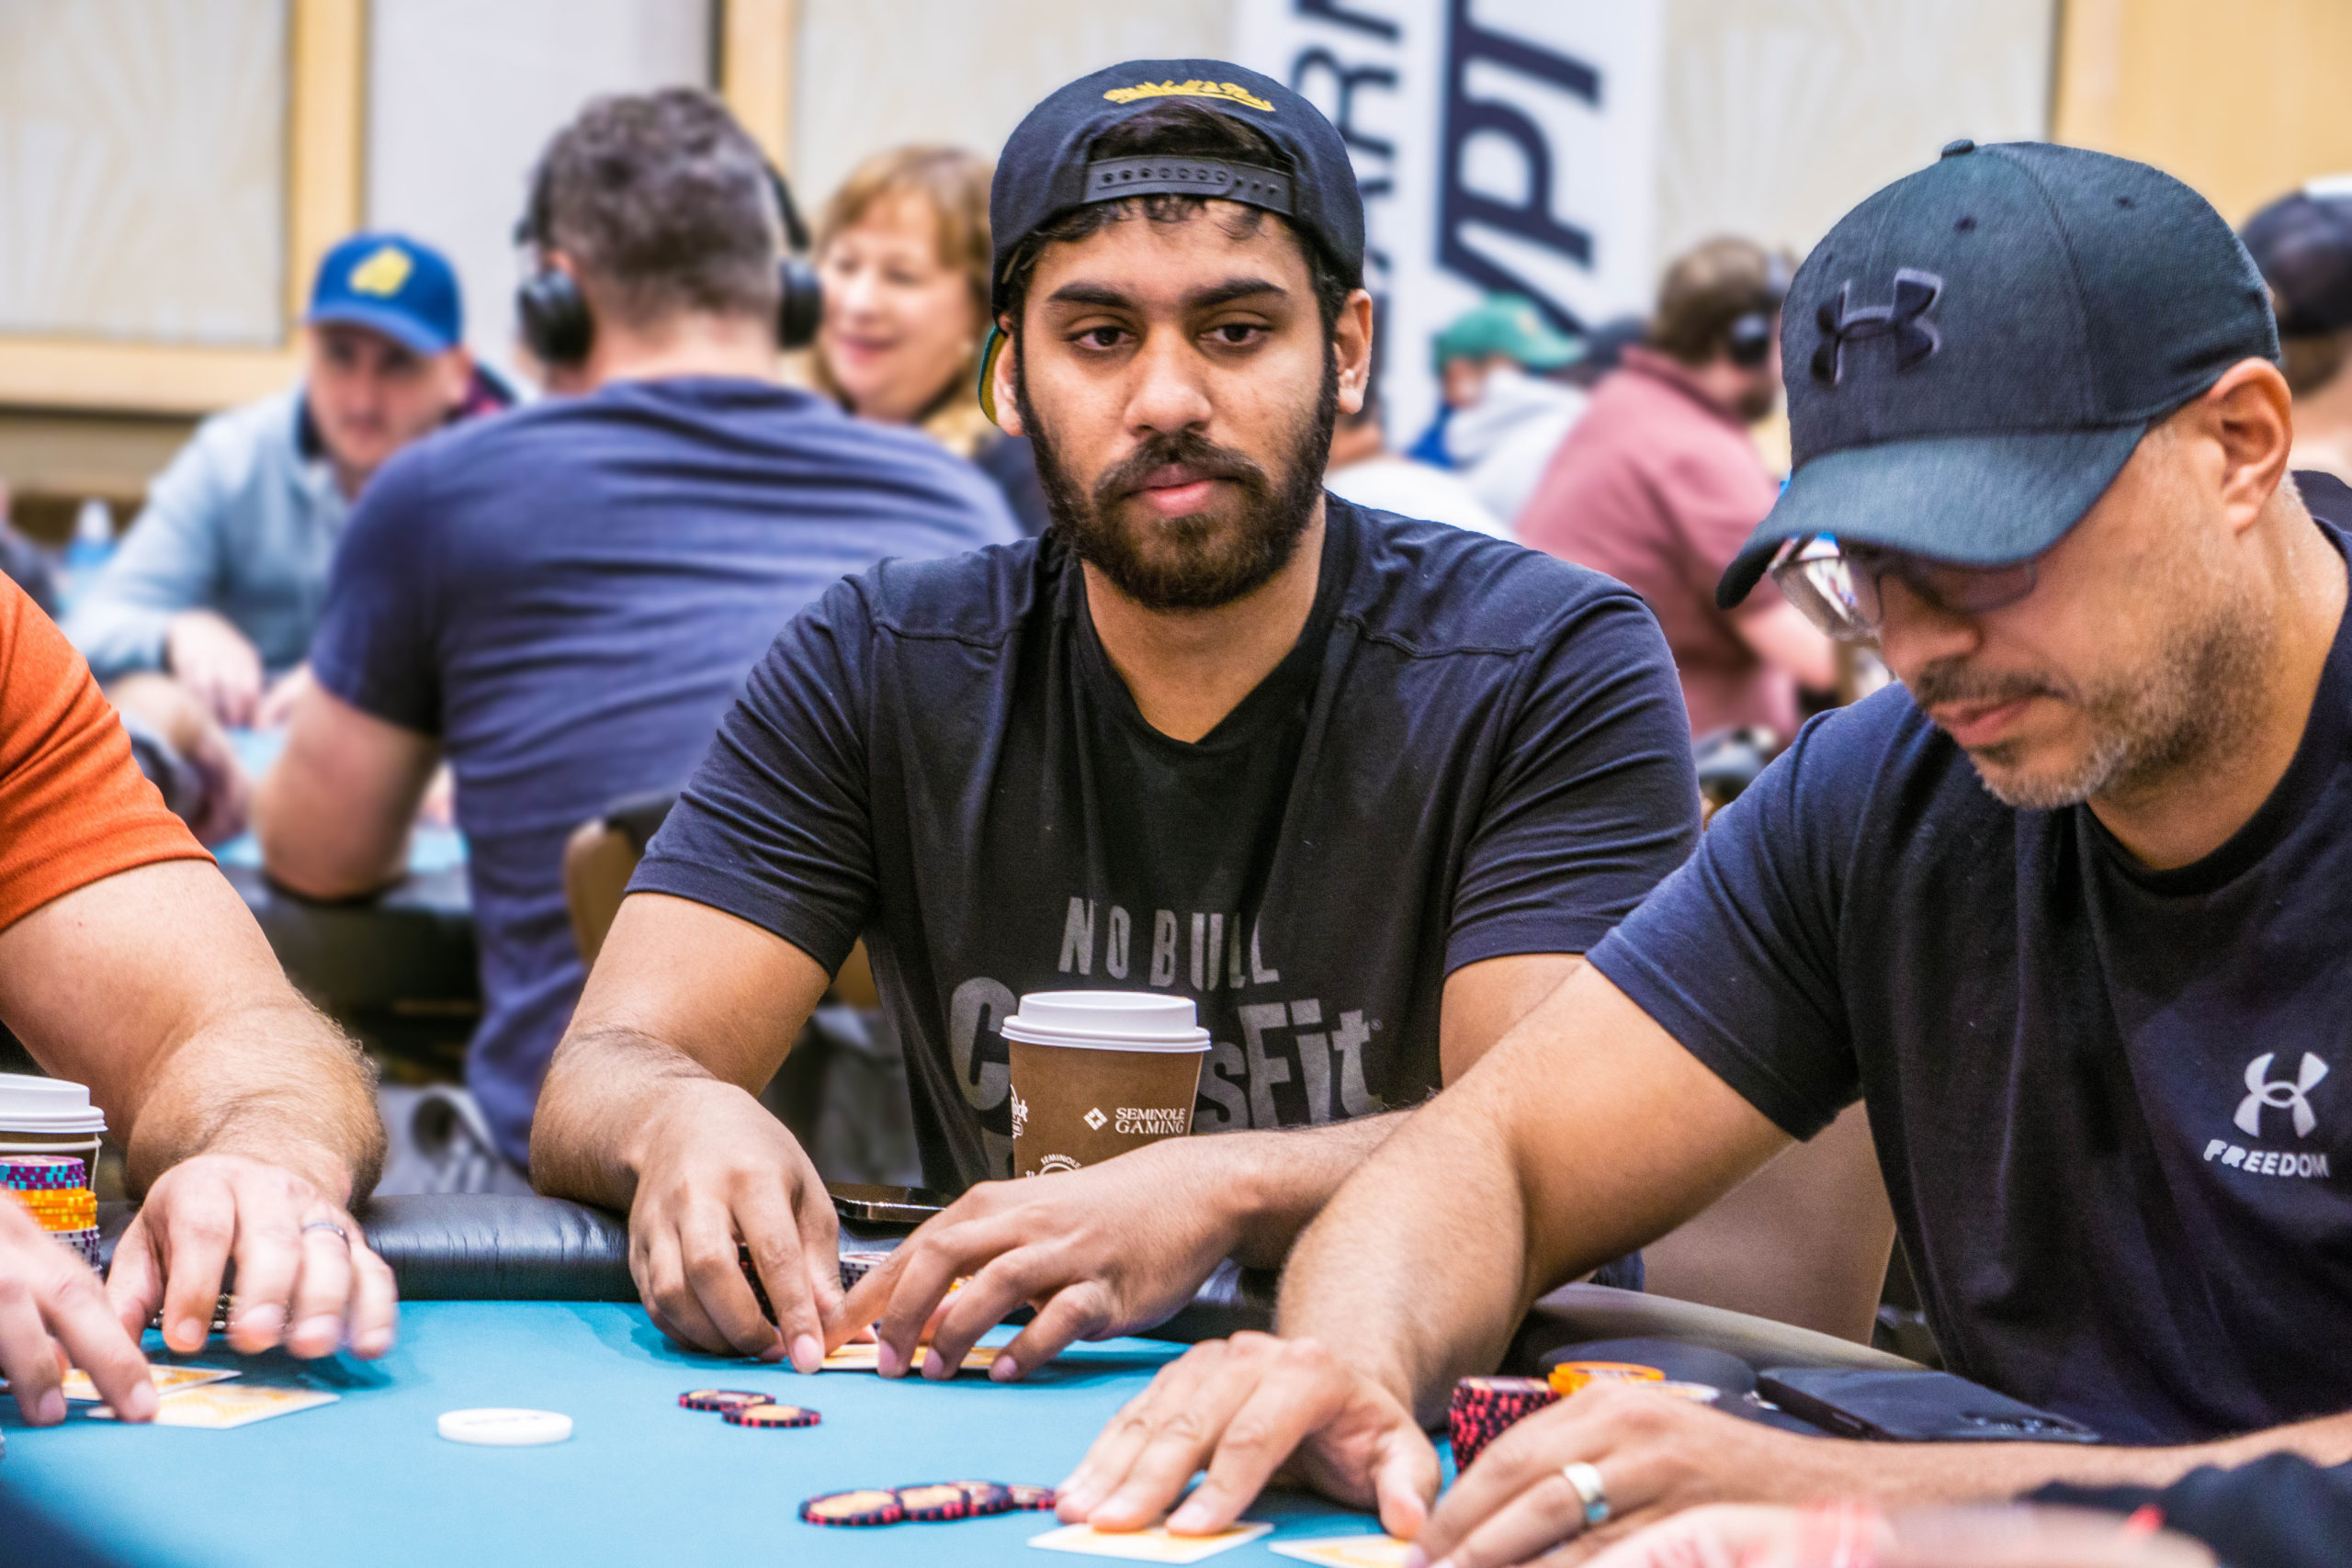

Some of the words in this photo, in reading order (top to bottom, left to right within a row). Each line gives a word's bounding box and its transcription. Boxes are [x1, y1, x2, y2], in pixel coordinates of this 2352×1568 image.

[1436, 0, 1600, 334] PT
[1057, 897, 1131, 980] NO
[1149, 908, 1281, 991] BULL
[949, 976, 1382, 1135] CsFit
[1114, 1106, 1186, 1122] SEMINOLE
[1114, 1120, 1185, 1134] GAMING
[2203, 1138, 2332, 1179] FREEDOM
